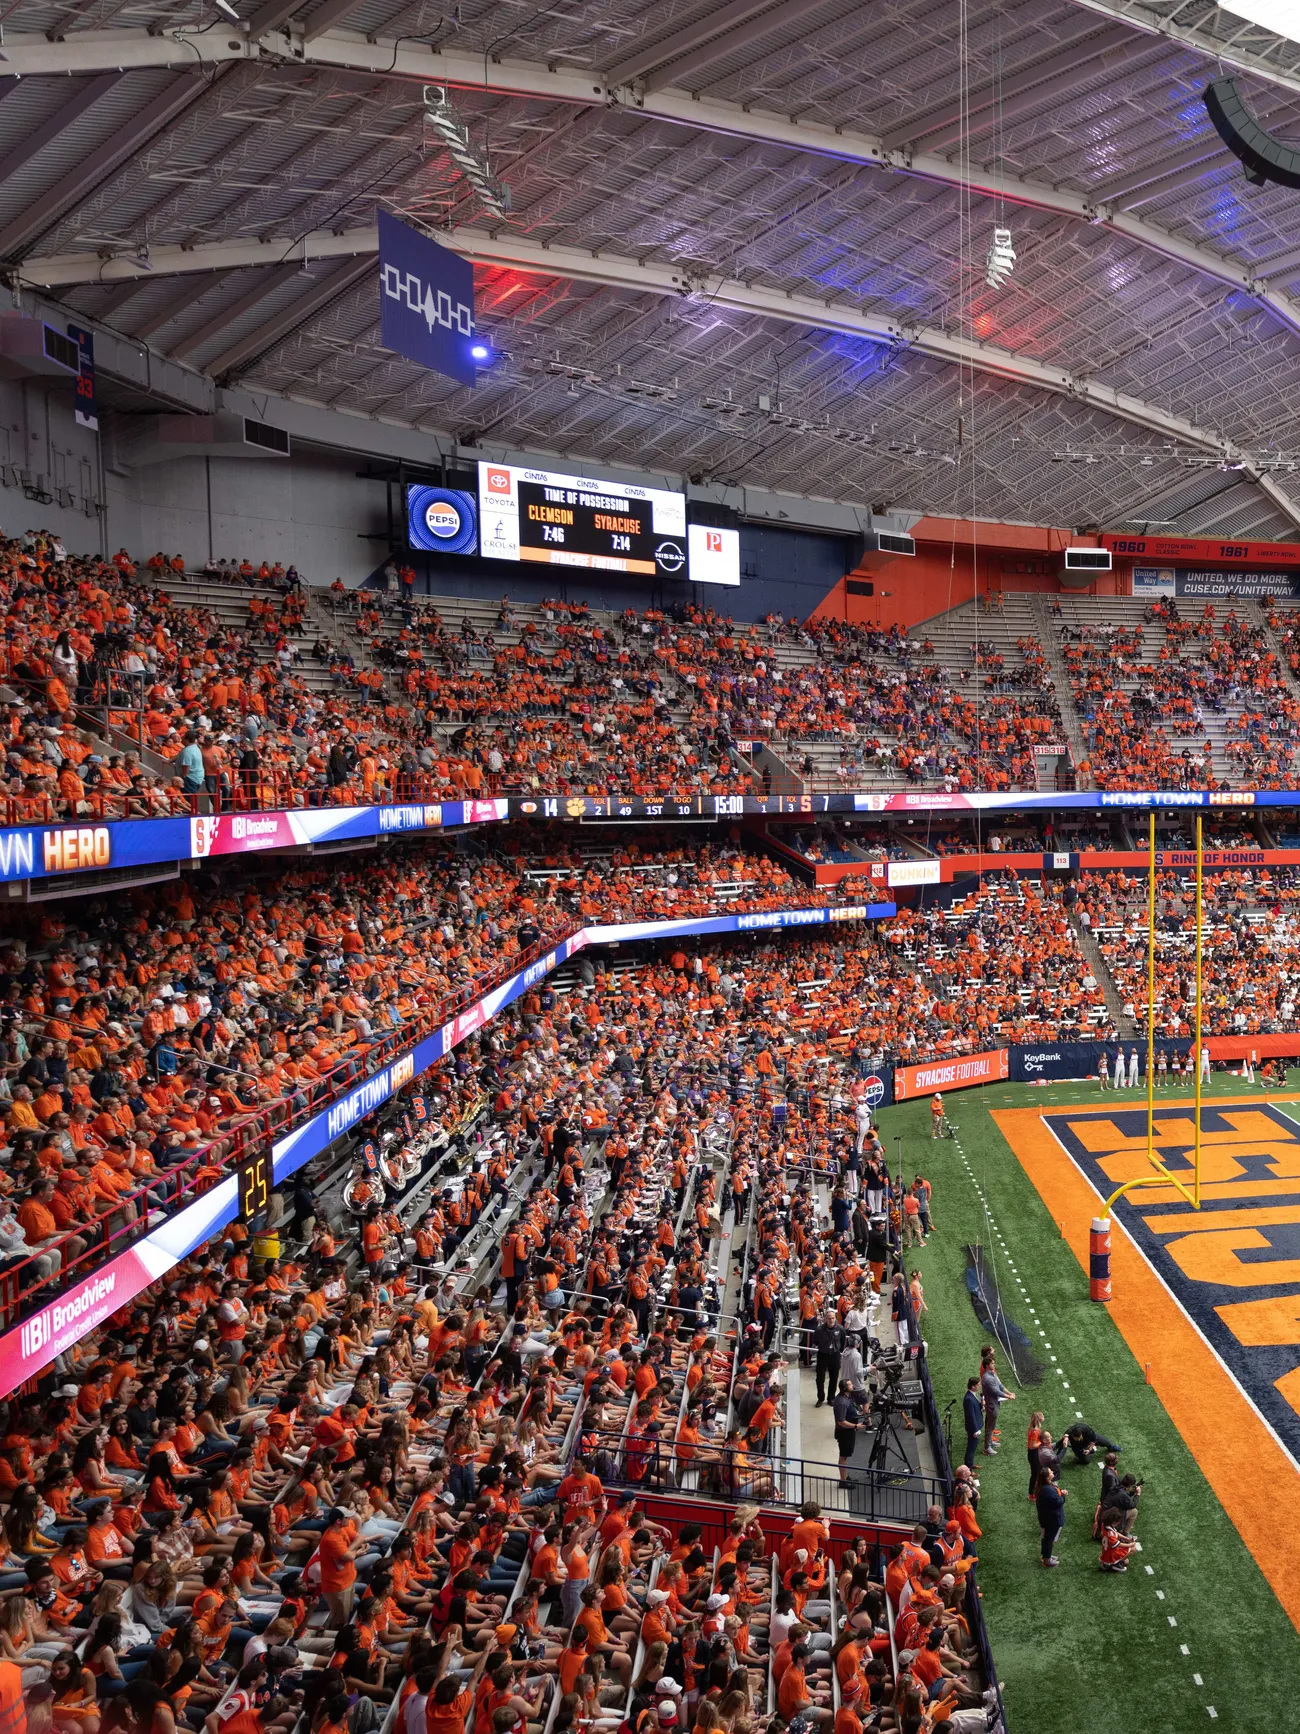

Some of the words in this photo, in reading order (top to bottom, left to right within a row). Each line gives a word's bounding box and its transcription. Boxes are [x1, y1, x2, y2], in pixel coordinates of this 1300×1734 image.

[76, 375, 93, 399] 33
[484, 497, 515, 507] TOYOTA
[544, 488, 565, 503] TIME
[566, 491, 577, 504] OF
[580, 493, 630, 512] POSSESSION
[429, 515, 458, 525] PEPSI
[528, 505, 574, 525] CLEMSON
[594, 514, 641, 534] SYRACUSE
[543, 525, 565, 543] 7:46
[611, 535, 631, 551] 7:14
[1112, 541, 1146, 553] 1960
[1219, 546, 1249, 558] 1961
[655, 552, 685, 562] NISSAN
[1136, 570, 1156, 578] United
[1144, 577, 1156, 585] Way
[1187, 572, 1225, 584] UNITED,
[1227, 574, 1242, 583] WE
[1245, 574, 1258, 583] DO
[1260, 574, 1290, 584] MORE.
[1184, 584, 1294, 596] CUSE.COM/UNITEDWAY
[738, 743, 752, 752] 314
[714, 796, 744, 814] 15:00
[801, 795, 811, 812] S
[823, 796, 829, 811] 7
[1102, 792, 1203, 806] HOMETOWN
[1209, 793, 1255, 805] HERO
[544, 798, 558, 817] 14
[595, 806, 602, 816] 2
[620, 807, 632, 816] 49
[646, 806, 663, 815] 1ST
[679, 805, 690, 815] 10
[761, 805, 767, 813] 1
[788, 804, 794, 813] 3
[379, 806, 423, 831] HOMETOWN
[424, 805, 442, 826] HERO
[44, 828, 110, 872] HERO
[1204, 854, 1220, 863] OF
[1222, 853, 1265, 863] HONOR
[891, 867, 938, 881] DUNKIN'
[738, 910, 825, 928] HOMETOWN
[829, 906, 867, 921] HERO
[1024, 1053, 1061, 1063] KeyBank
[915, 1067, 955, 1088] SYRACUSE
[956, 1059, 990, 1080] FOOTBALL
[328, 1071, 389, 1139] HOMETOWN
[390, 1053, 414, 1091] HERO
[412, 1096, 427, 1121] S
[364, 1143, 378, 1171] S
[245, 1158, 268, 1218] 25
[53, 1272, 116, 1333] Broadview
[54, 1327, 76, 1353] Federal
[75, 1315, 92, 1337] Credit
[92, 1305, 108, 1324] Union
